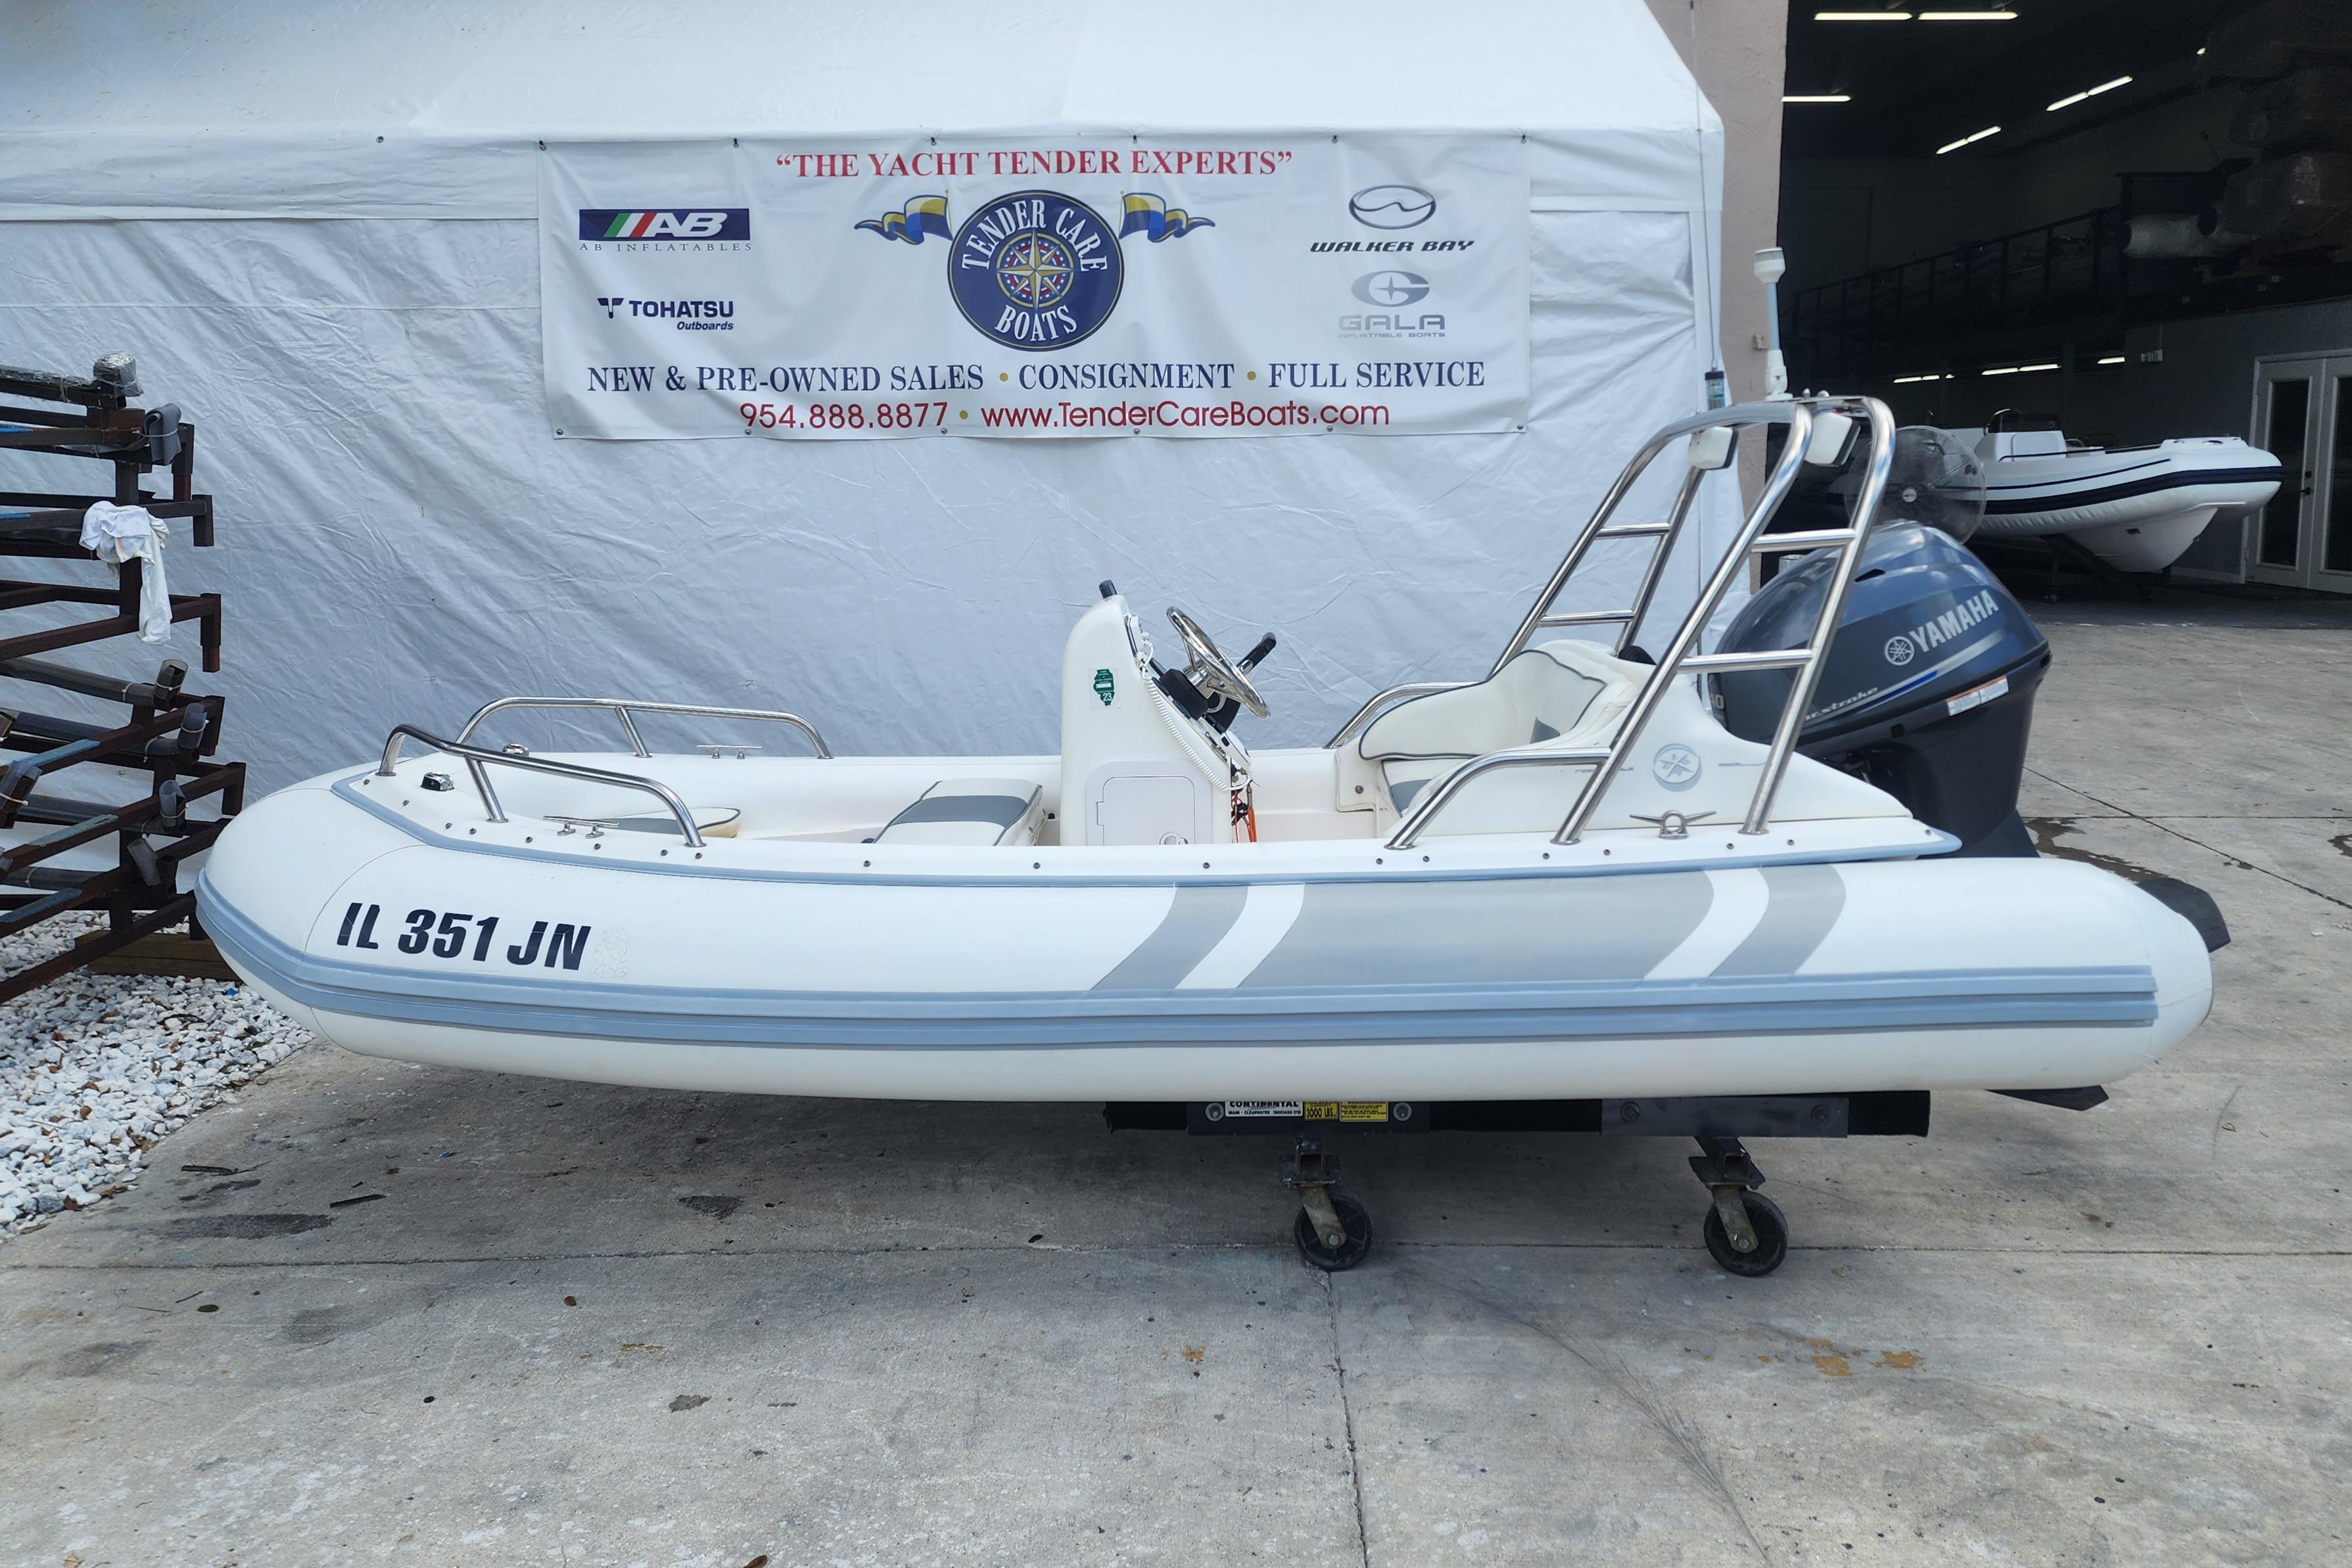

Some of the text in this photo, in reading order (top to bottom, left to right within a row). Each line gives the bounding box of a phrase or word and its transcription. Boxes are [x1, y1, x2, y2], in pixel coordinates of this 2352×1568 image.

[867, 151, 979, 176] YACHT
[987, 150, 1122, 175] TENDER
[617, 242, 752, 252] INFLATABLES
[961, 199, 1108, 272] TENDER CARE
[1309, 240, 1475, 252] WALKER BAY
[628, 300, 734, 318] TOHATSU
[676, 321, 734, 331] Outboards
[994, 304, 1077, 342] BOATS
[1338, 314, 1446, 331] GALA
[586, 361, 1486, 392] NEW & PRE-OWNED SALES CONSIGNMENT FULL SERVICE
[739, 400, 1390, 429] 954.888.8877 www.TenderCareBoats.com
[1909, 589, 2000, 653] YAMAHA
[1102, 692, 1112, 701] 23
[336, 902, 592, 971] IL 351 JN
